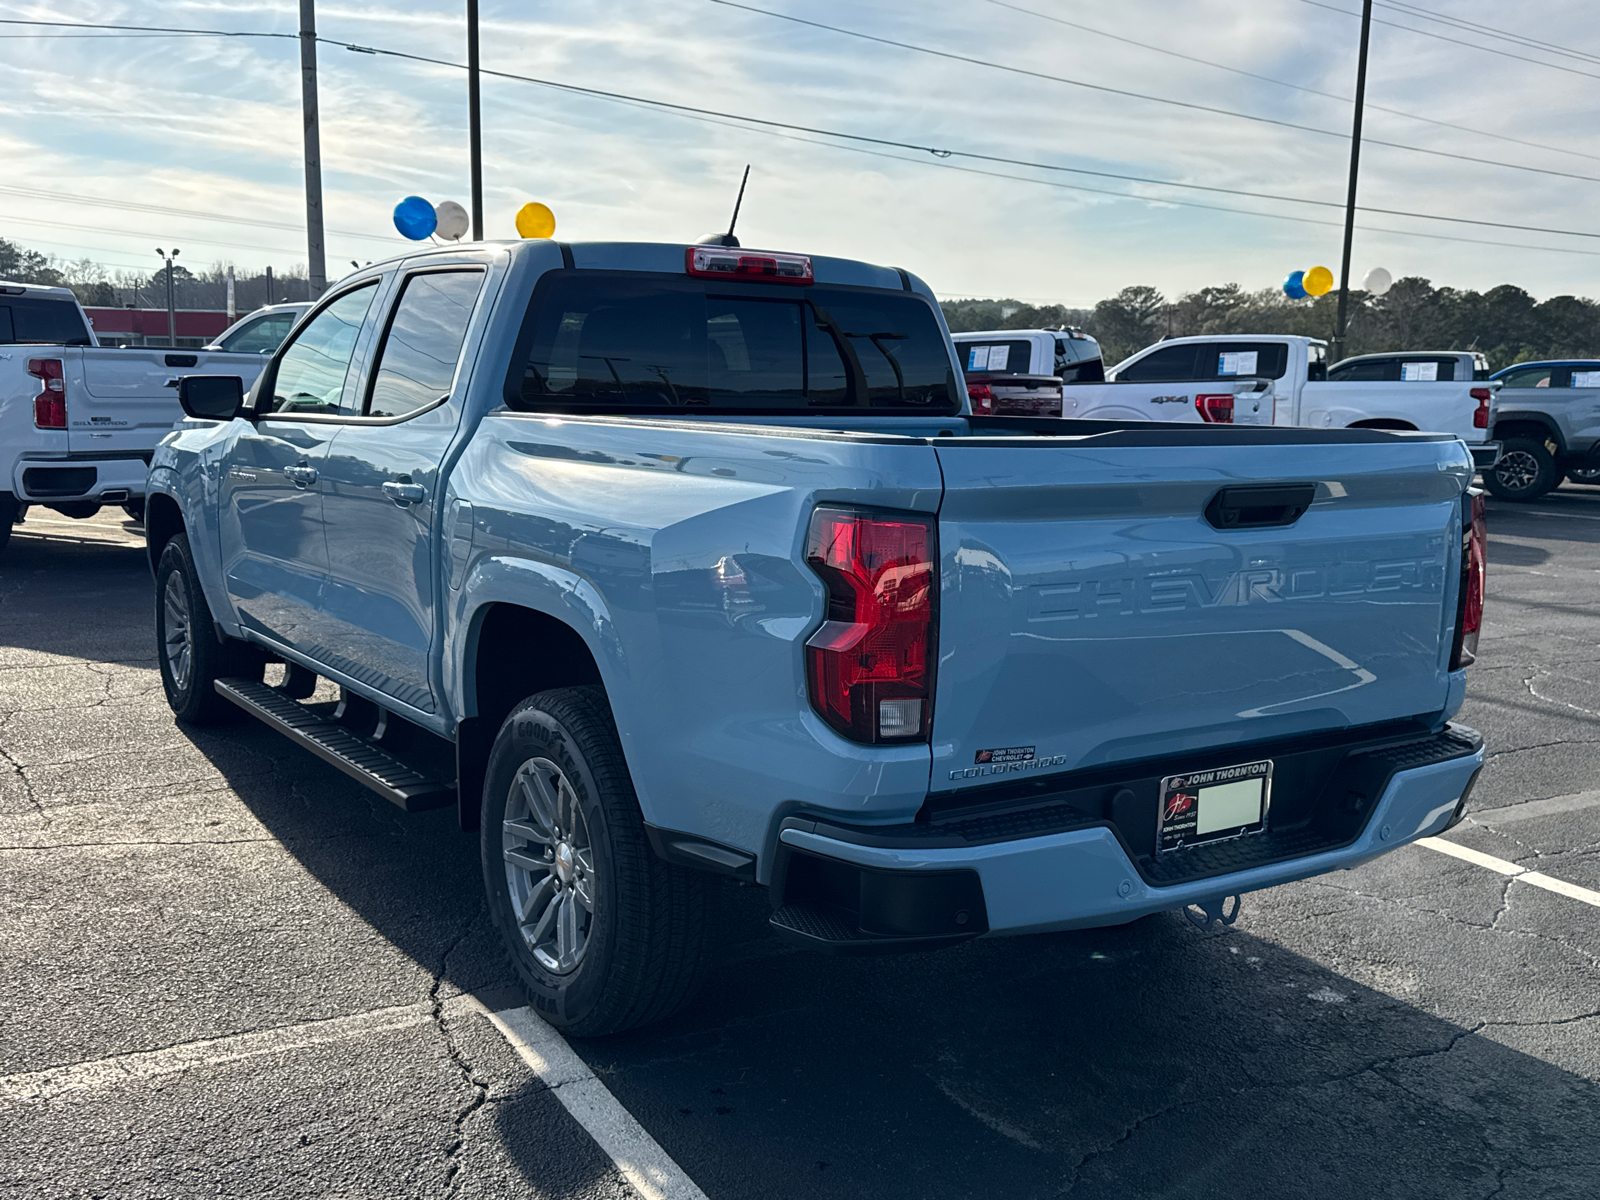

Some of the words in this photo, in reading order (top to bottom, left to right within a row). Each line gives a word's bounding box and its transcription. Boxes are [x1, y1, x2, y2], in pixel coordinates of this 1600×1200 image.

[1028, 556, 1438, 623] CHEVROLET
[991, 754, 1023, 763] CHEVROLET
[992, 749, 1007, 757] JOHN
[1007, 747, 1034, 755] THORNTON
[949, 755, 1067, 780] COLORADO
[1187, 772, 1214, 785] JOHN
[1216, 763, 1266, 780] THORNTON
